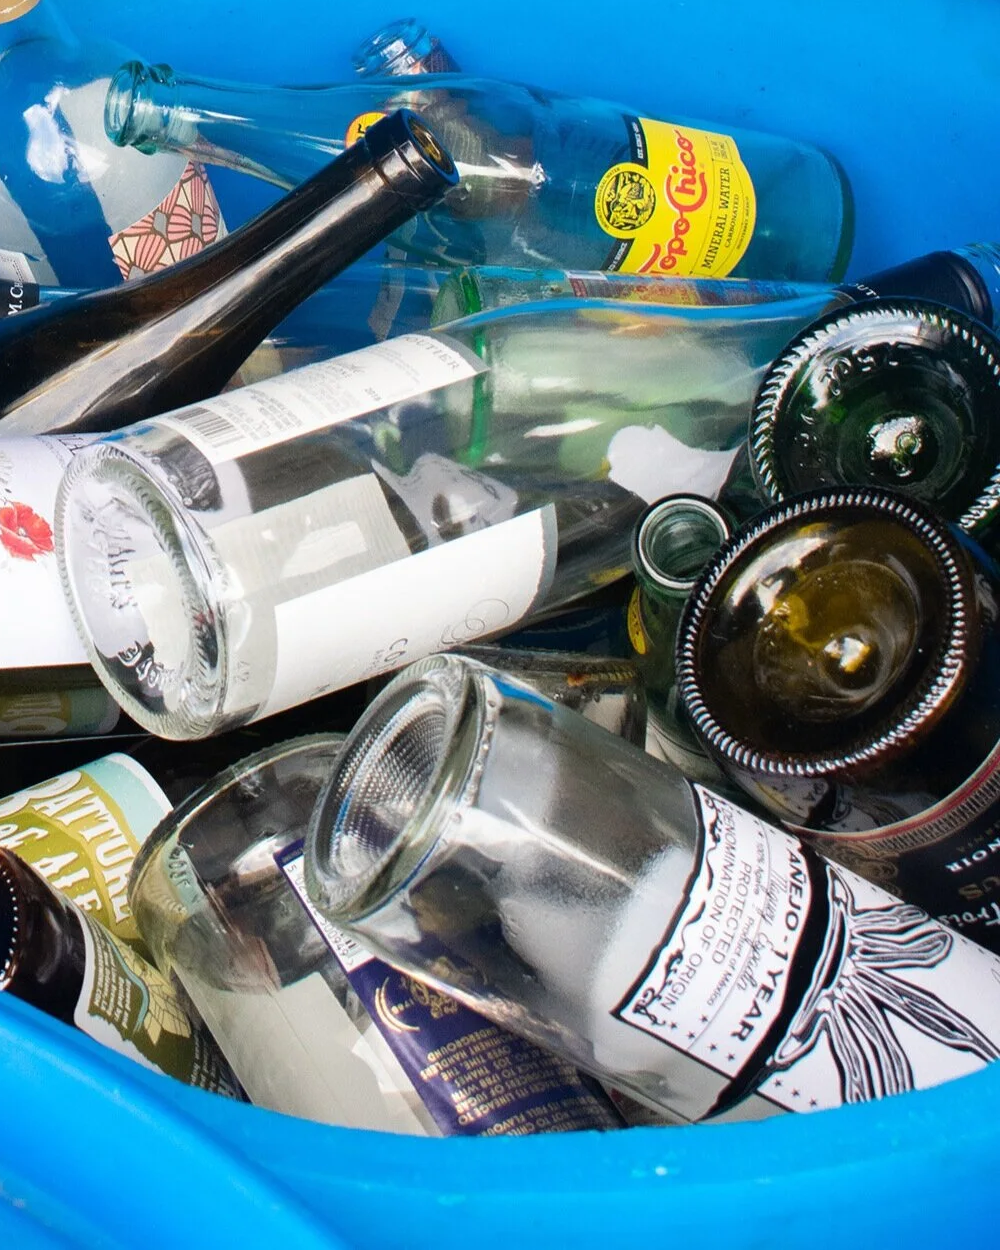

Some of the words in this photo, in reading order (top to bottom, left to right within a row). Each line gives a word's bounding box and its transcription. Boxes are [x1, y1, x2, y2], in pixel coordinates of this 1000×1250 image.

[637, 215, 691, 274] Topo
[667, 129, 706, 211] Chico
[701, 214, 726, 268] MINERAL
[719, 167, 728, 208] WATER
[724, 194, 739, 248] CARBONATED
[708, 808, 731, 920] DENOMINATION
[755, 868, 788, 926] Maguey
[786, 848, 807, 932] AÑEJO
[710, 861, 750, 965] PROTECTED
[696, 923, 717, 951] OF
[733, 916, 753, 956] Product
[726, 957, 737, 970] of
[773, 947, 789, 960] 1
[659, 950, 703, 1011] ORIGIN
[730, 968, 785, 1043] YEAR
[425, 1025, 498, 1063] UNDERGROUND
[486, 1044, 510, 1060] OVER
[418, 1051, 468, 1080] HANDLERS
[439, 1065, 459, 1082] THE
[452, 1064, 489, 1087] THAMES
[449, 1082, 478, 1103] WITH
[453, 1090, 487, 1114] SUGAR
[486, 1082, 504, 1097] OF
[455, 1111, 473, 1126] TO
[473, 1092, 515, 1117] LINEAGE
